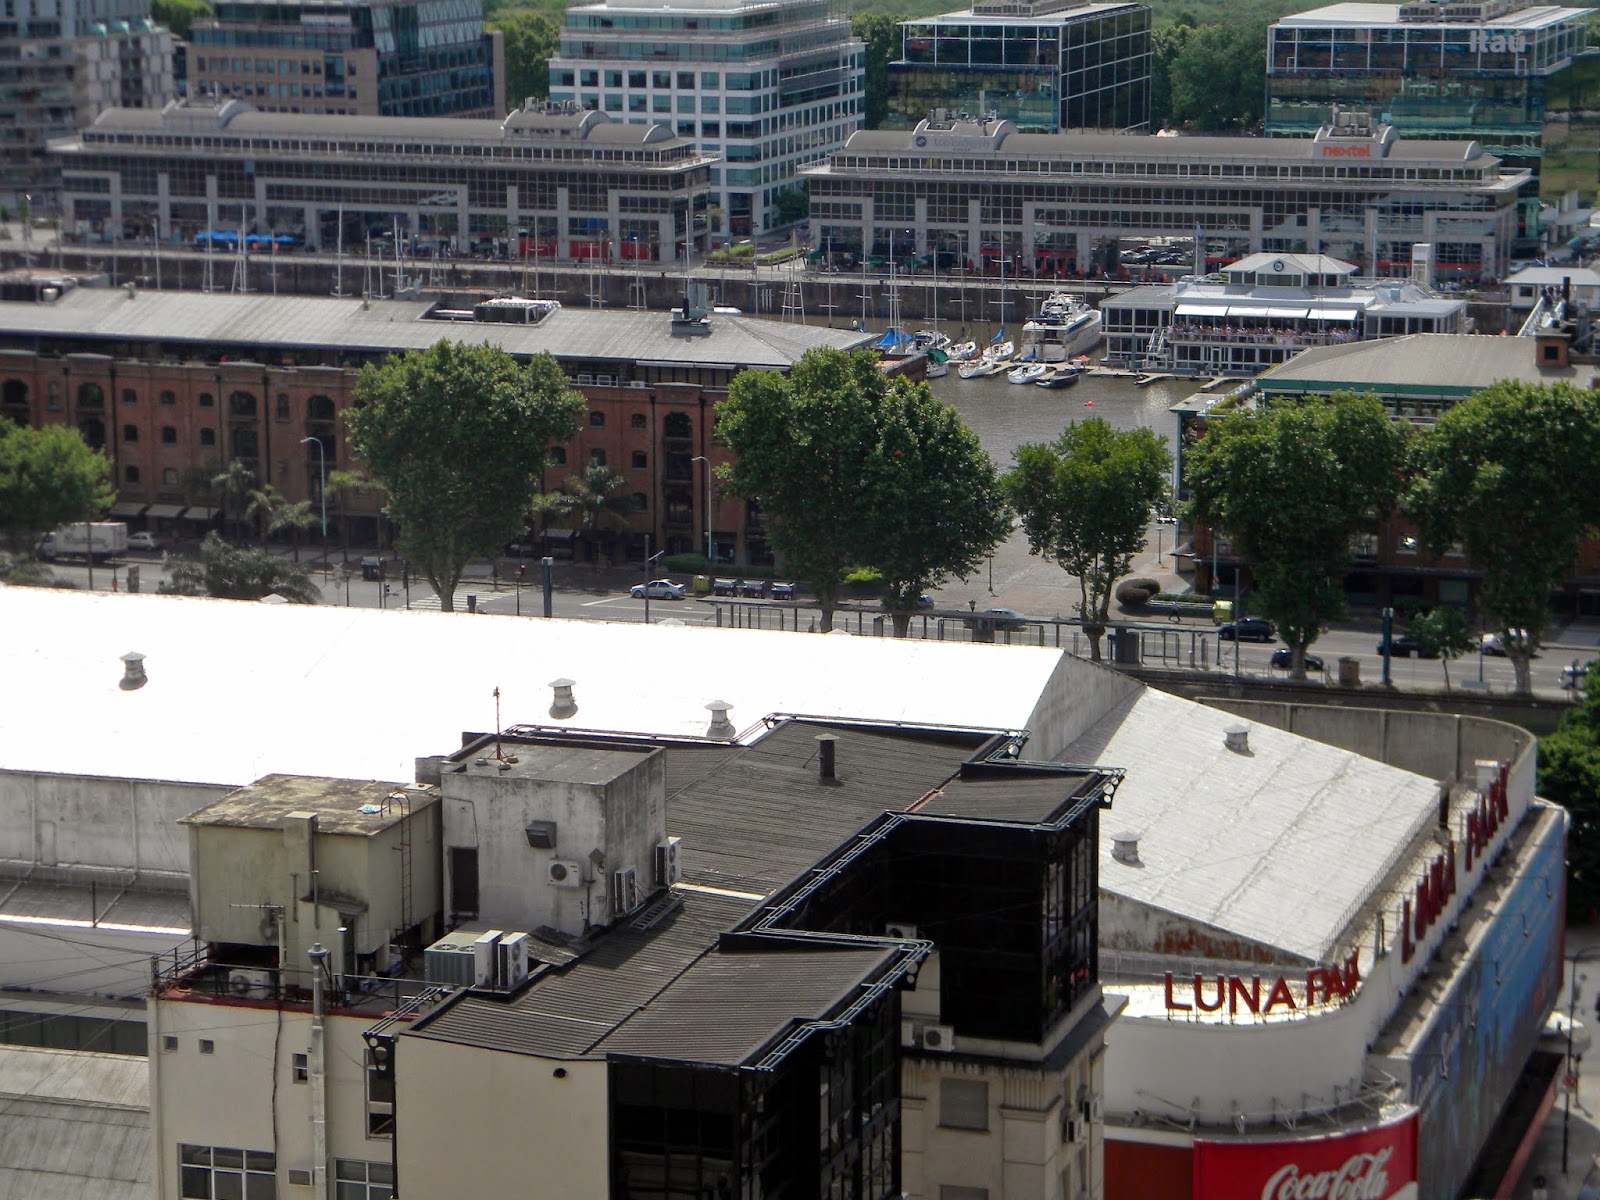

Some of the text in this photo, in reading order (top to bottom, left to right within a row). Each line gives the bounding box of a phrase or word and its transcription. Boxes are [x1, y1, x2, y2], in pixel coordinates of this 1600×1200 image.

[1469, 30, 1526, 53] Itaú
[1322, 144, 1370, 157] nextel
[1165, 970, 1297, 1014] LUNA
